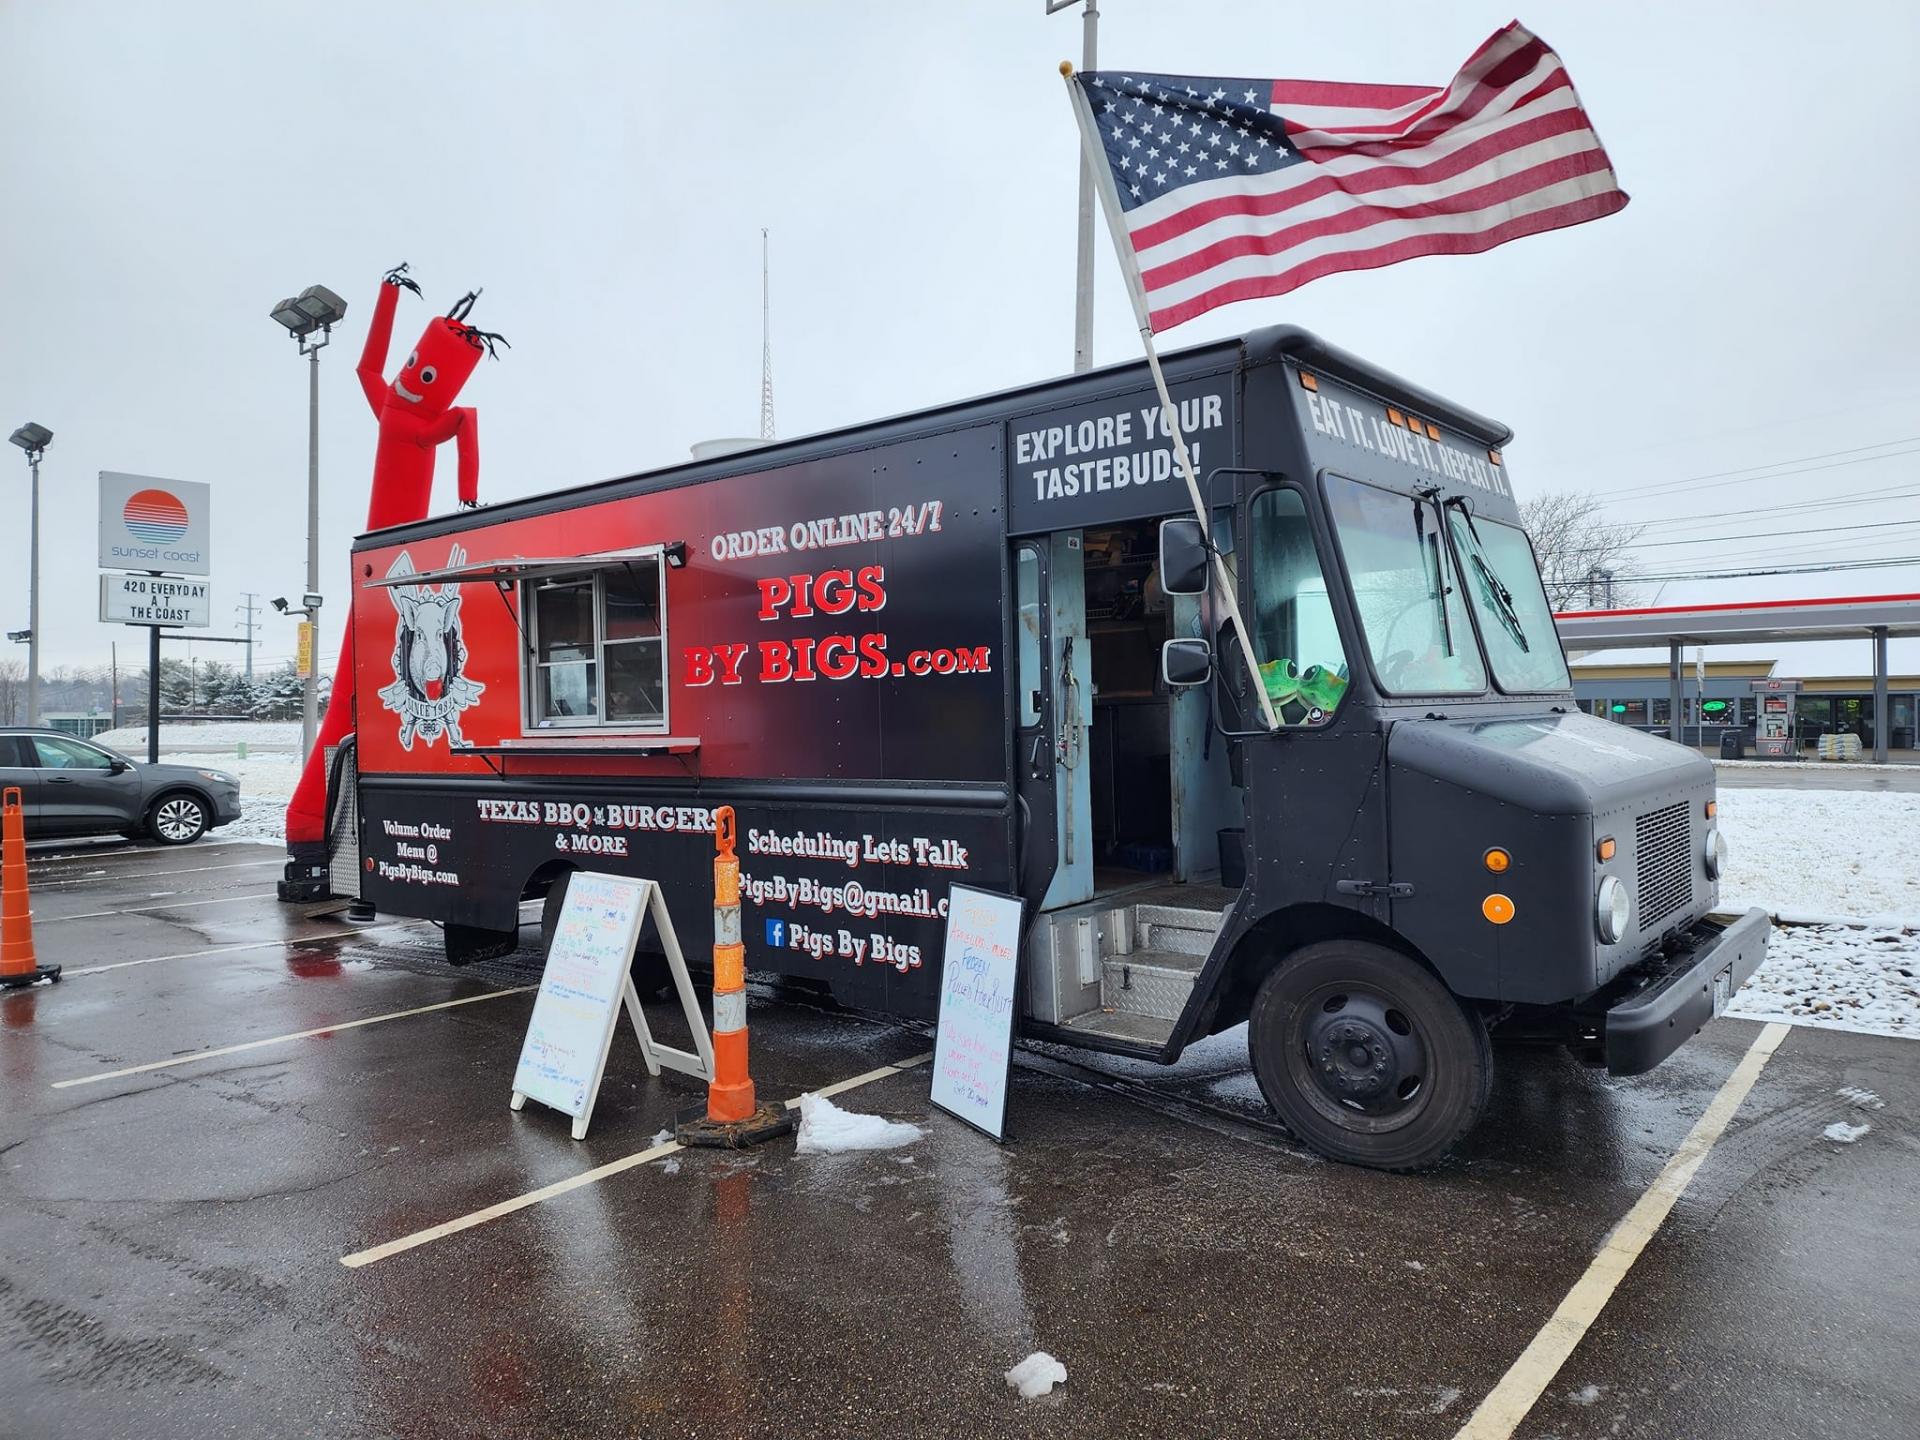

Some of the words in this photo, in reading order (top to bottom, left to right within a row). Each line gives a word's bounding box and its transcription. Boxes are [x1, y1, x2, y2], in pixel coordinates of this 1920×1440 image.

[1016, 412, 1131, 464] EXPLORE
[1140, 394, 1223, 440] YOUR
[1305, 390, 1346, 439] EAT
[1371, 416, 1419, 466] LOVE
[1436, 443, 1491, 490] REPEAT
[1033, 442, 1200, 500] TASTEBUDS!
[711, 525, 788, 561] ORDER
[790, 510, 885, 551] ONLINE
[887, 500, 943, 536] 24/7
[111, 546, 158, 559] sunset
[163, 550, 200, 563] coast
[123, 581, 146, 593] 420
[151, 582, 205, 597] EVERYDAY
[757, 564, 887, 621] PIGS
[131, 606, 152, 619] THE
[155, 607, 190, 621] COAST
[683, 643, 749, 686] BY
[382, 820, 419, 837] Volume
[420, 822, 452, 840] Order
[477, 799, 541, 823] TEXAS
[544, 801, 591, 831] BBQ
[396, 842, 425, 858] Menu
[426, 844, 438, 864] @
[555, 833, 569, 851] &
[571, 835, 627, 855] MORE
[748, 829, 860, 868] Scheduling
[862, 834, 911, 865] Lets
[913, 837, 969, 869] Talk
[379, 861, 460, 885] PigsByBigs.com
[789, 923, 834, 960] Pigs
[837, 929, 867, 967] By
[870, 933, 922, 974] Bigs
